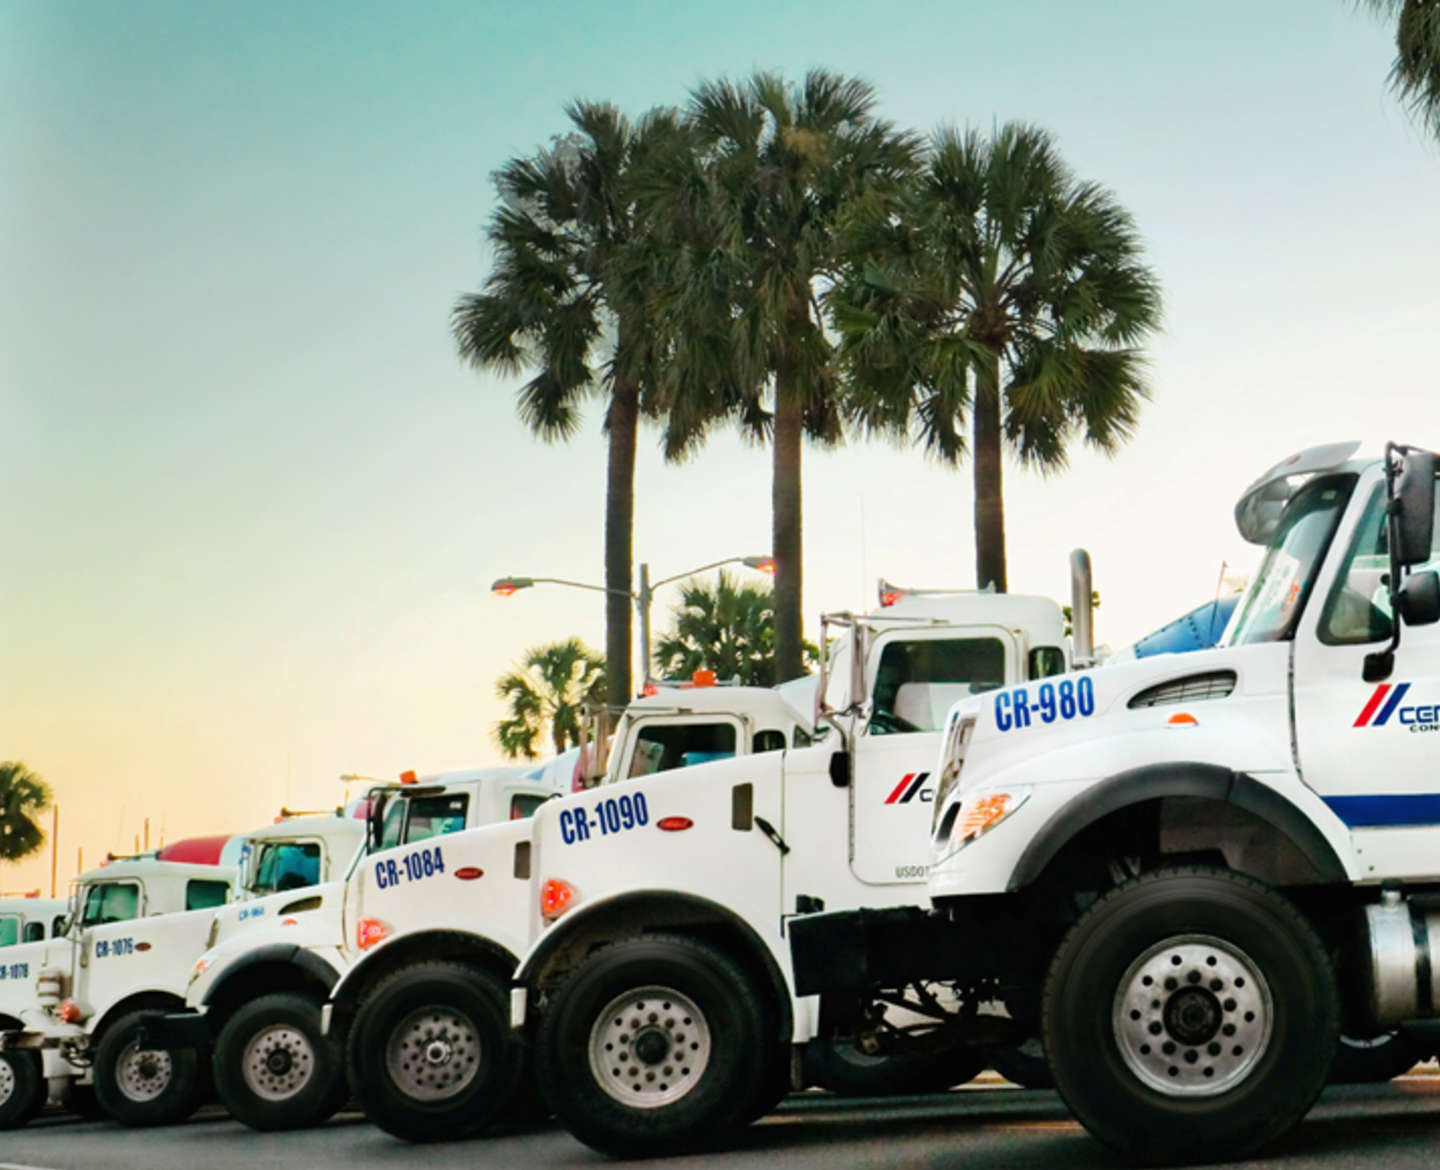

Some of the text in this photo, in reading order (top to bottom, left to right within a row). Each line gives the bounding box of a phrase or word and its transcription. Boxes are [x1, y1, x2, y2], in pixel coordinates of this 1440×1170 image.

[994, 675, 1095, 732] CR-980
[559, 791, 649, 845] CR-1090
[375, 846, 445, 890] CR-1084
